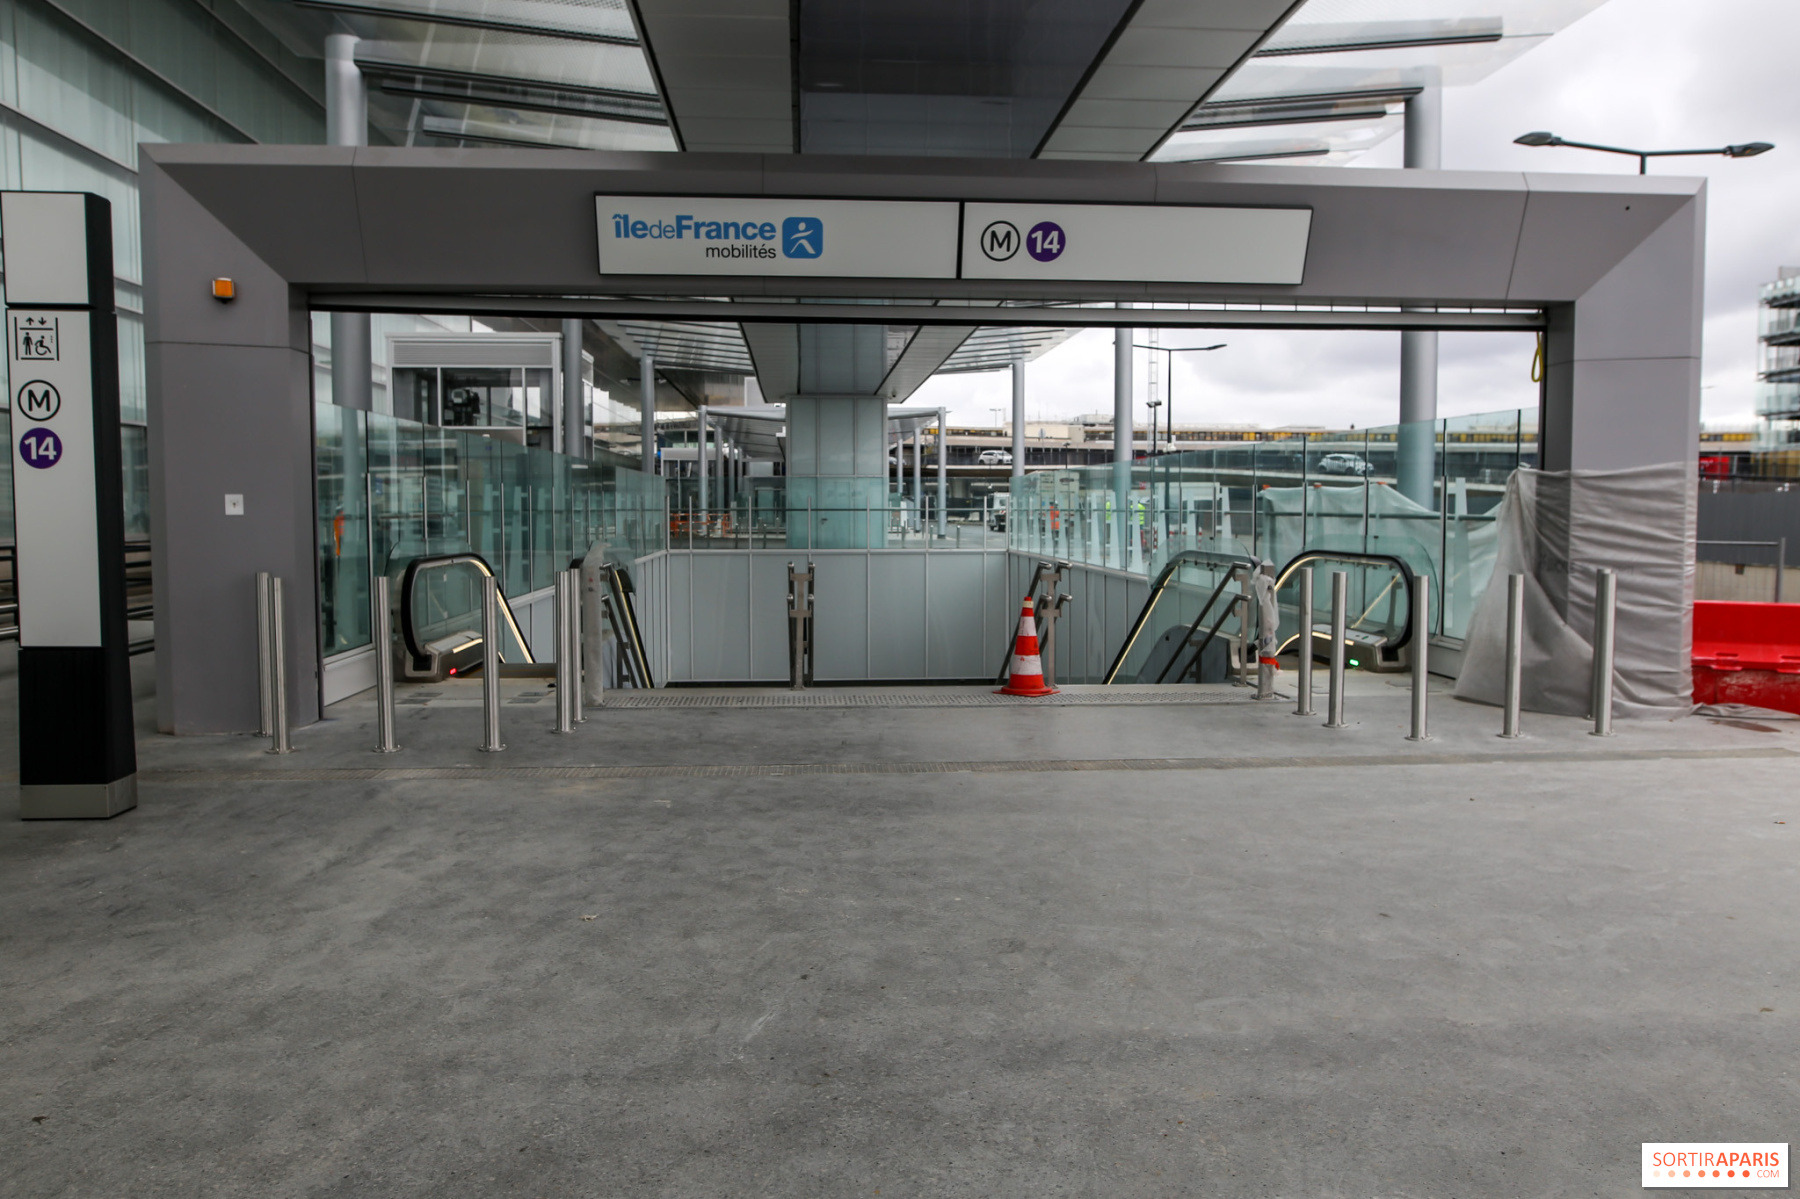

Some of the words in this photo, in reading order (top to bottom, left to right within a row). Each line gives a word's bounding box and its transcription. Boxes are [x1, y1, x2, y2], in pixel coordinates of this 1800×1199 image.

[705, 243, 777, 259] mobilités
[989, 229, 1012, 253] M
[1031, 230, 1061, 254] 14
[27, 389, 51, 412] M
[24, 436, 57, 460] 14
